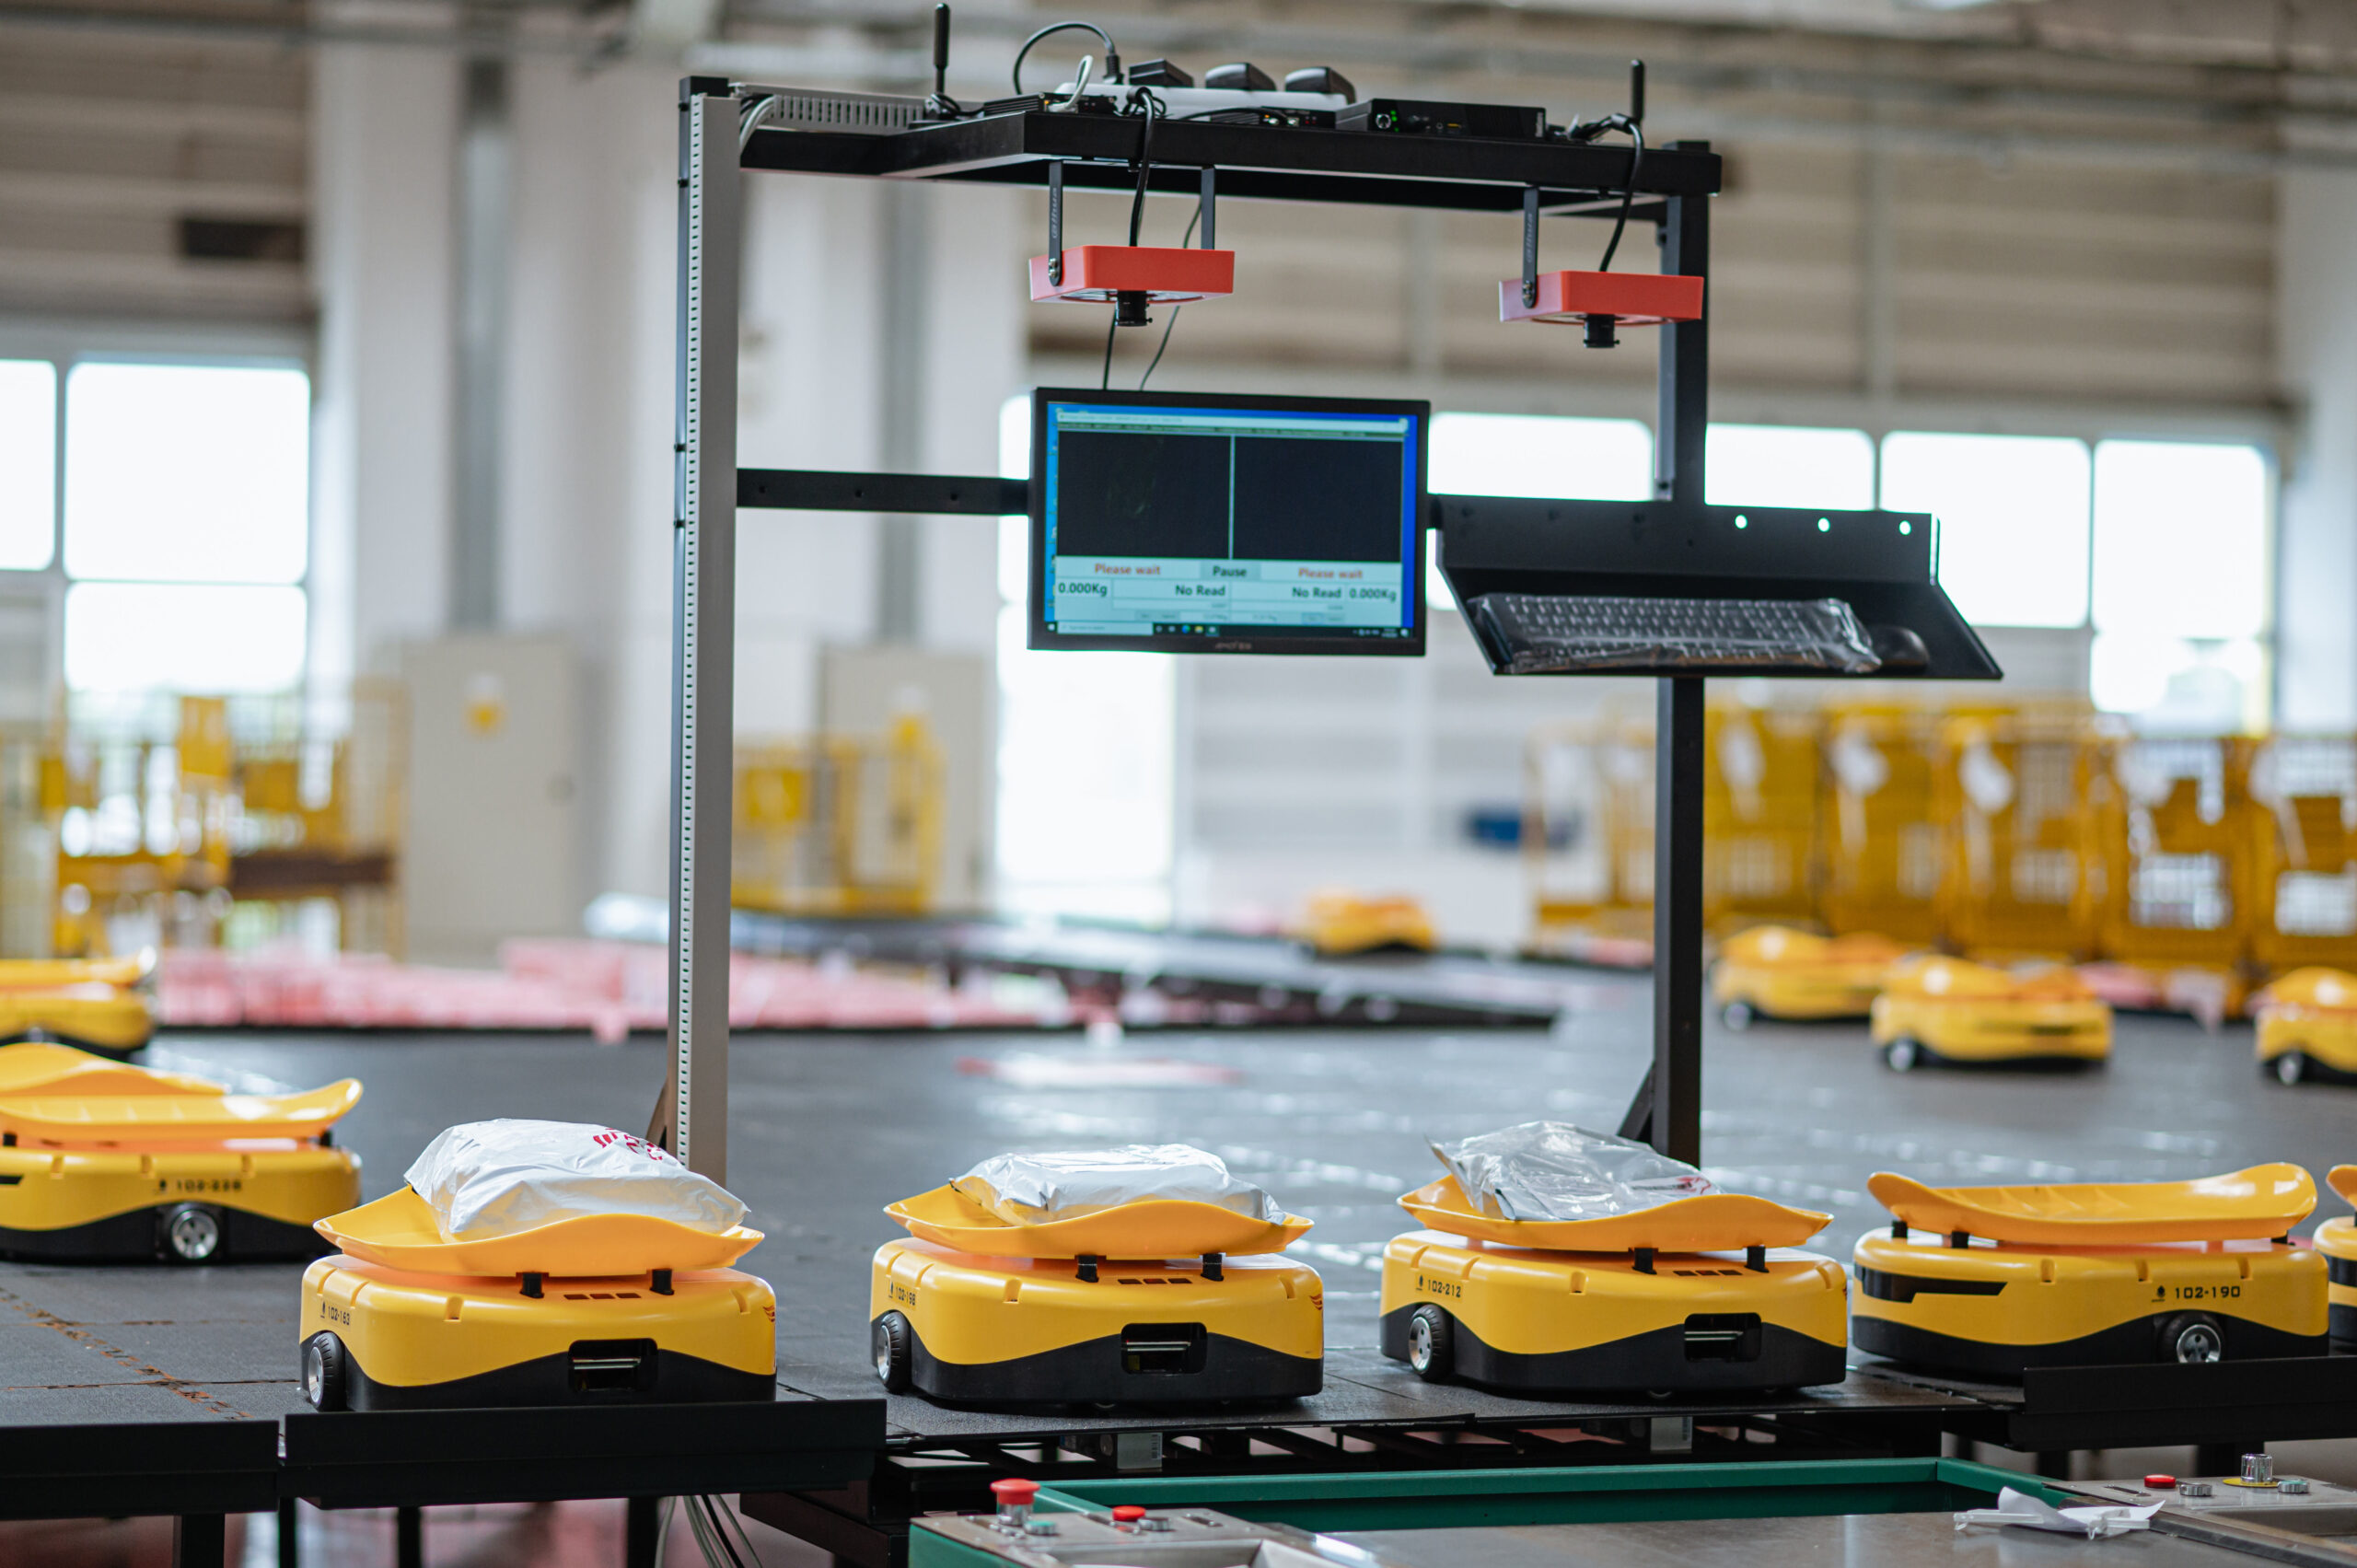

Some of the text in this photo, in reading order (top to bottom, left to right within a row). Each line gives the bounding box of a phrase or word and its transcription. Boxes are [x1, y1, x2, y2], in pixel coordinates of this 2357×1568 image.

[1095, 563, 1161, 575] Please wait
[1213, 565, 1247, 577] Pause
[1298, 568, 1363, 579] Please wait
[1058, 582, 1108, 597] 0.000Kg
[1175, 585, 1225, 597] No Read
[1292, 587, 1341, 598] No Read
[1349, 587, 1397, 602] 0.000Kg
